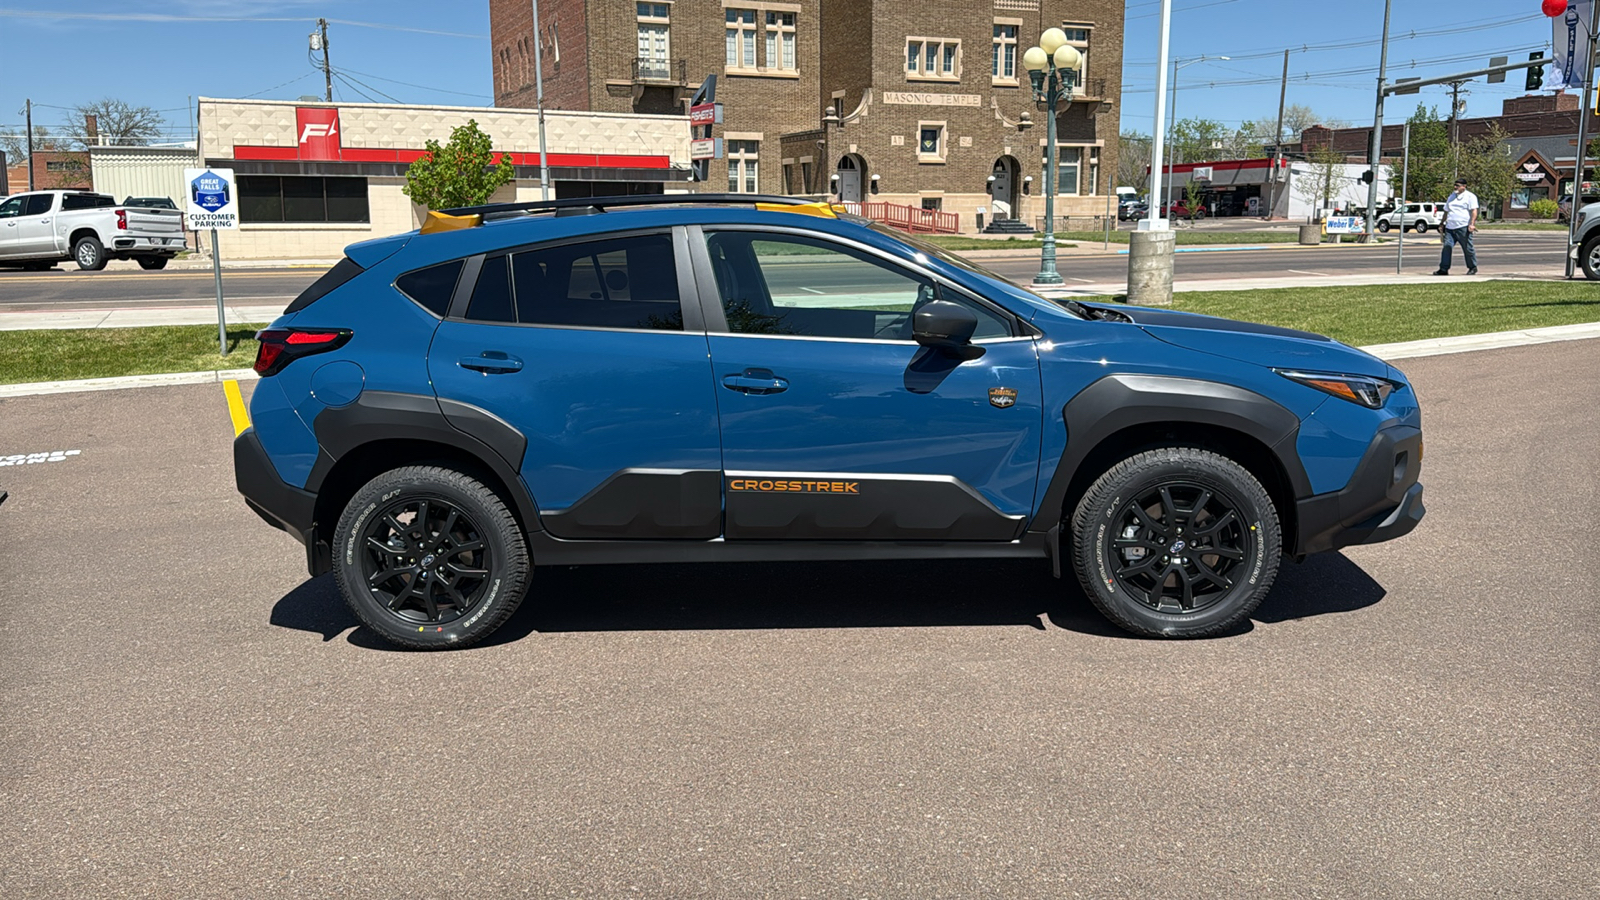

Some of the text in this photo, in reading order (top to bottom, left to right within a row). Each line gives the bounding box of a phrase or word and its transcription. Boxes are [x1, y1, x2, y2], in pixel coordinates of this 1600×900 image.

[885, 93, 980, 105] MASONIC TEMPLE
[1327, 218, 1348, 228] Weber
[730, 480, 858, 493] CROSSTREK
